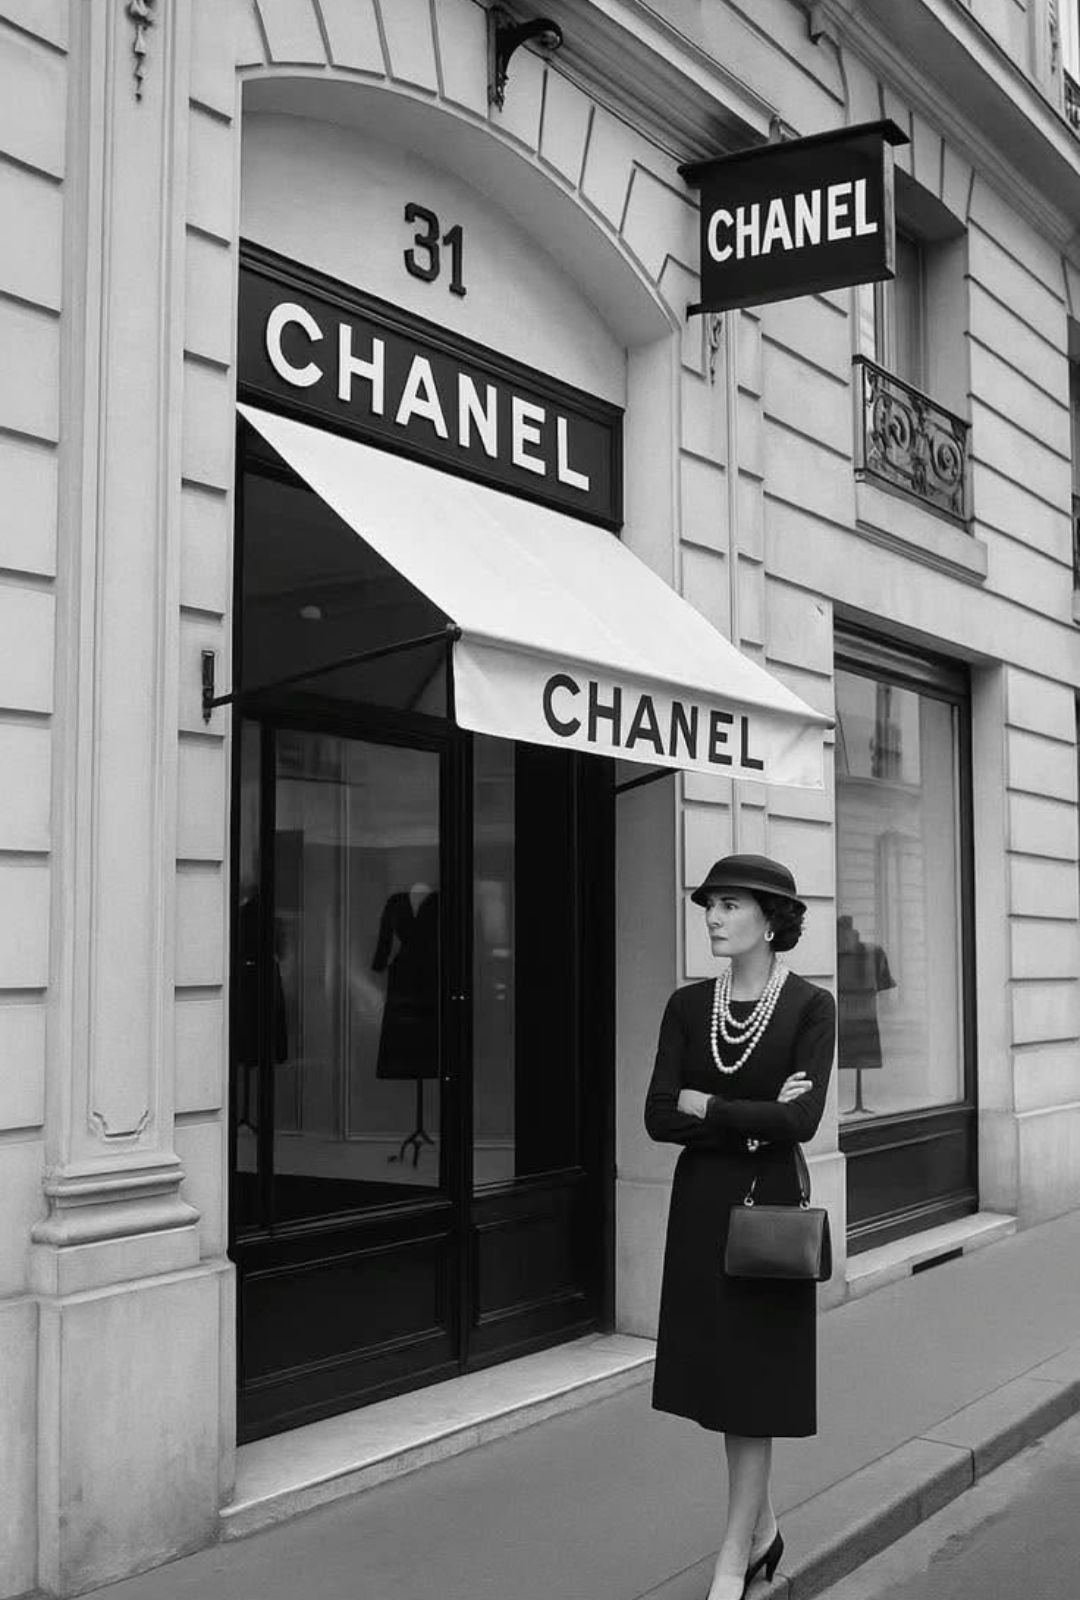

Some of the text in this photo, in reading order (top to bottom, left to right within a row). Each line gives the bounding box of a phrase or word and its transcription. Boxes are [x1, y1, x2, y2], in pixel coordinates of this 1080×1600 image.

[404, 202, 466, 299] 31
[707, 178, 878, 262] CHANEL
[266, 302, 590, 492] CHANEL
[542, 673, 764, 771] CHANEL
